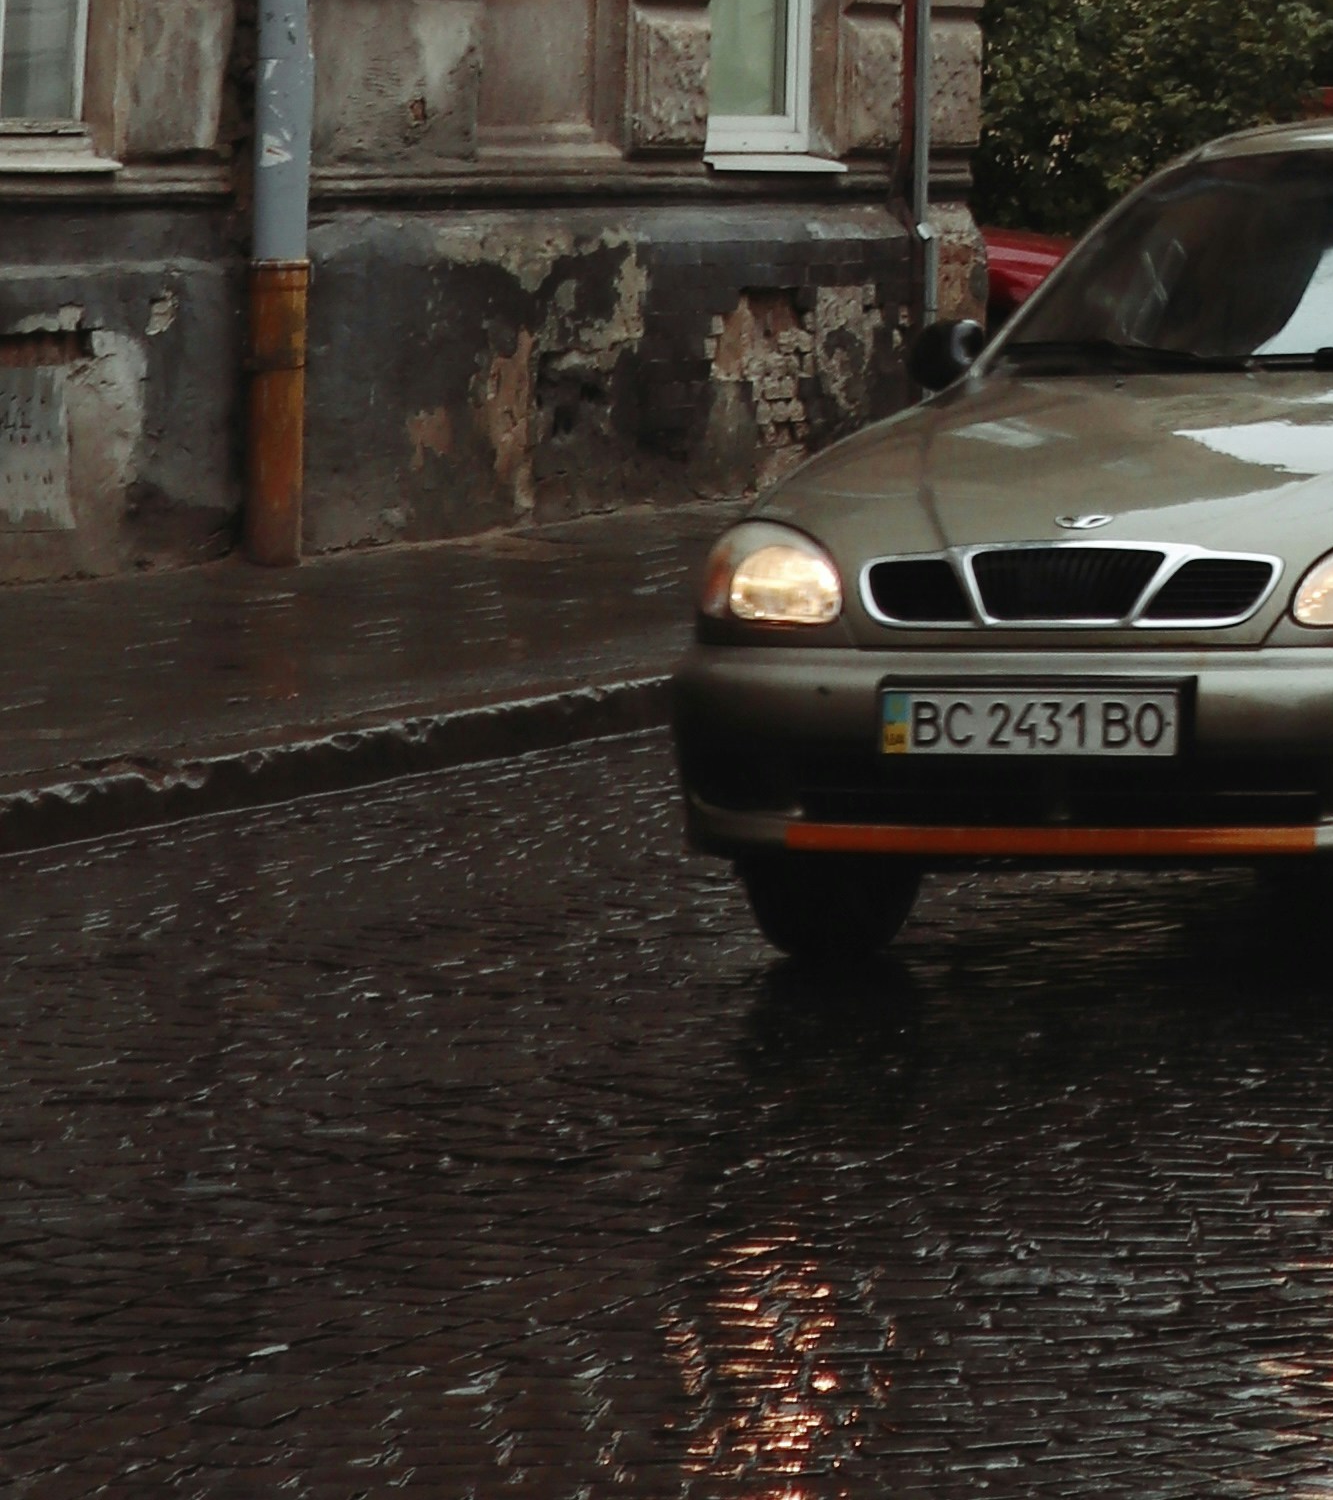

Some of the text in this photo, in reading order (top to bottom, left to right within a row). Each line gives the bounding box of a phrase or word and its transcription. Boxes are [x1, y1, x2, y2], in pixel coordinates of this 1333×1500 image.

[911, 701, 1164, 749] BC 2431 BO
